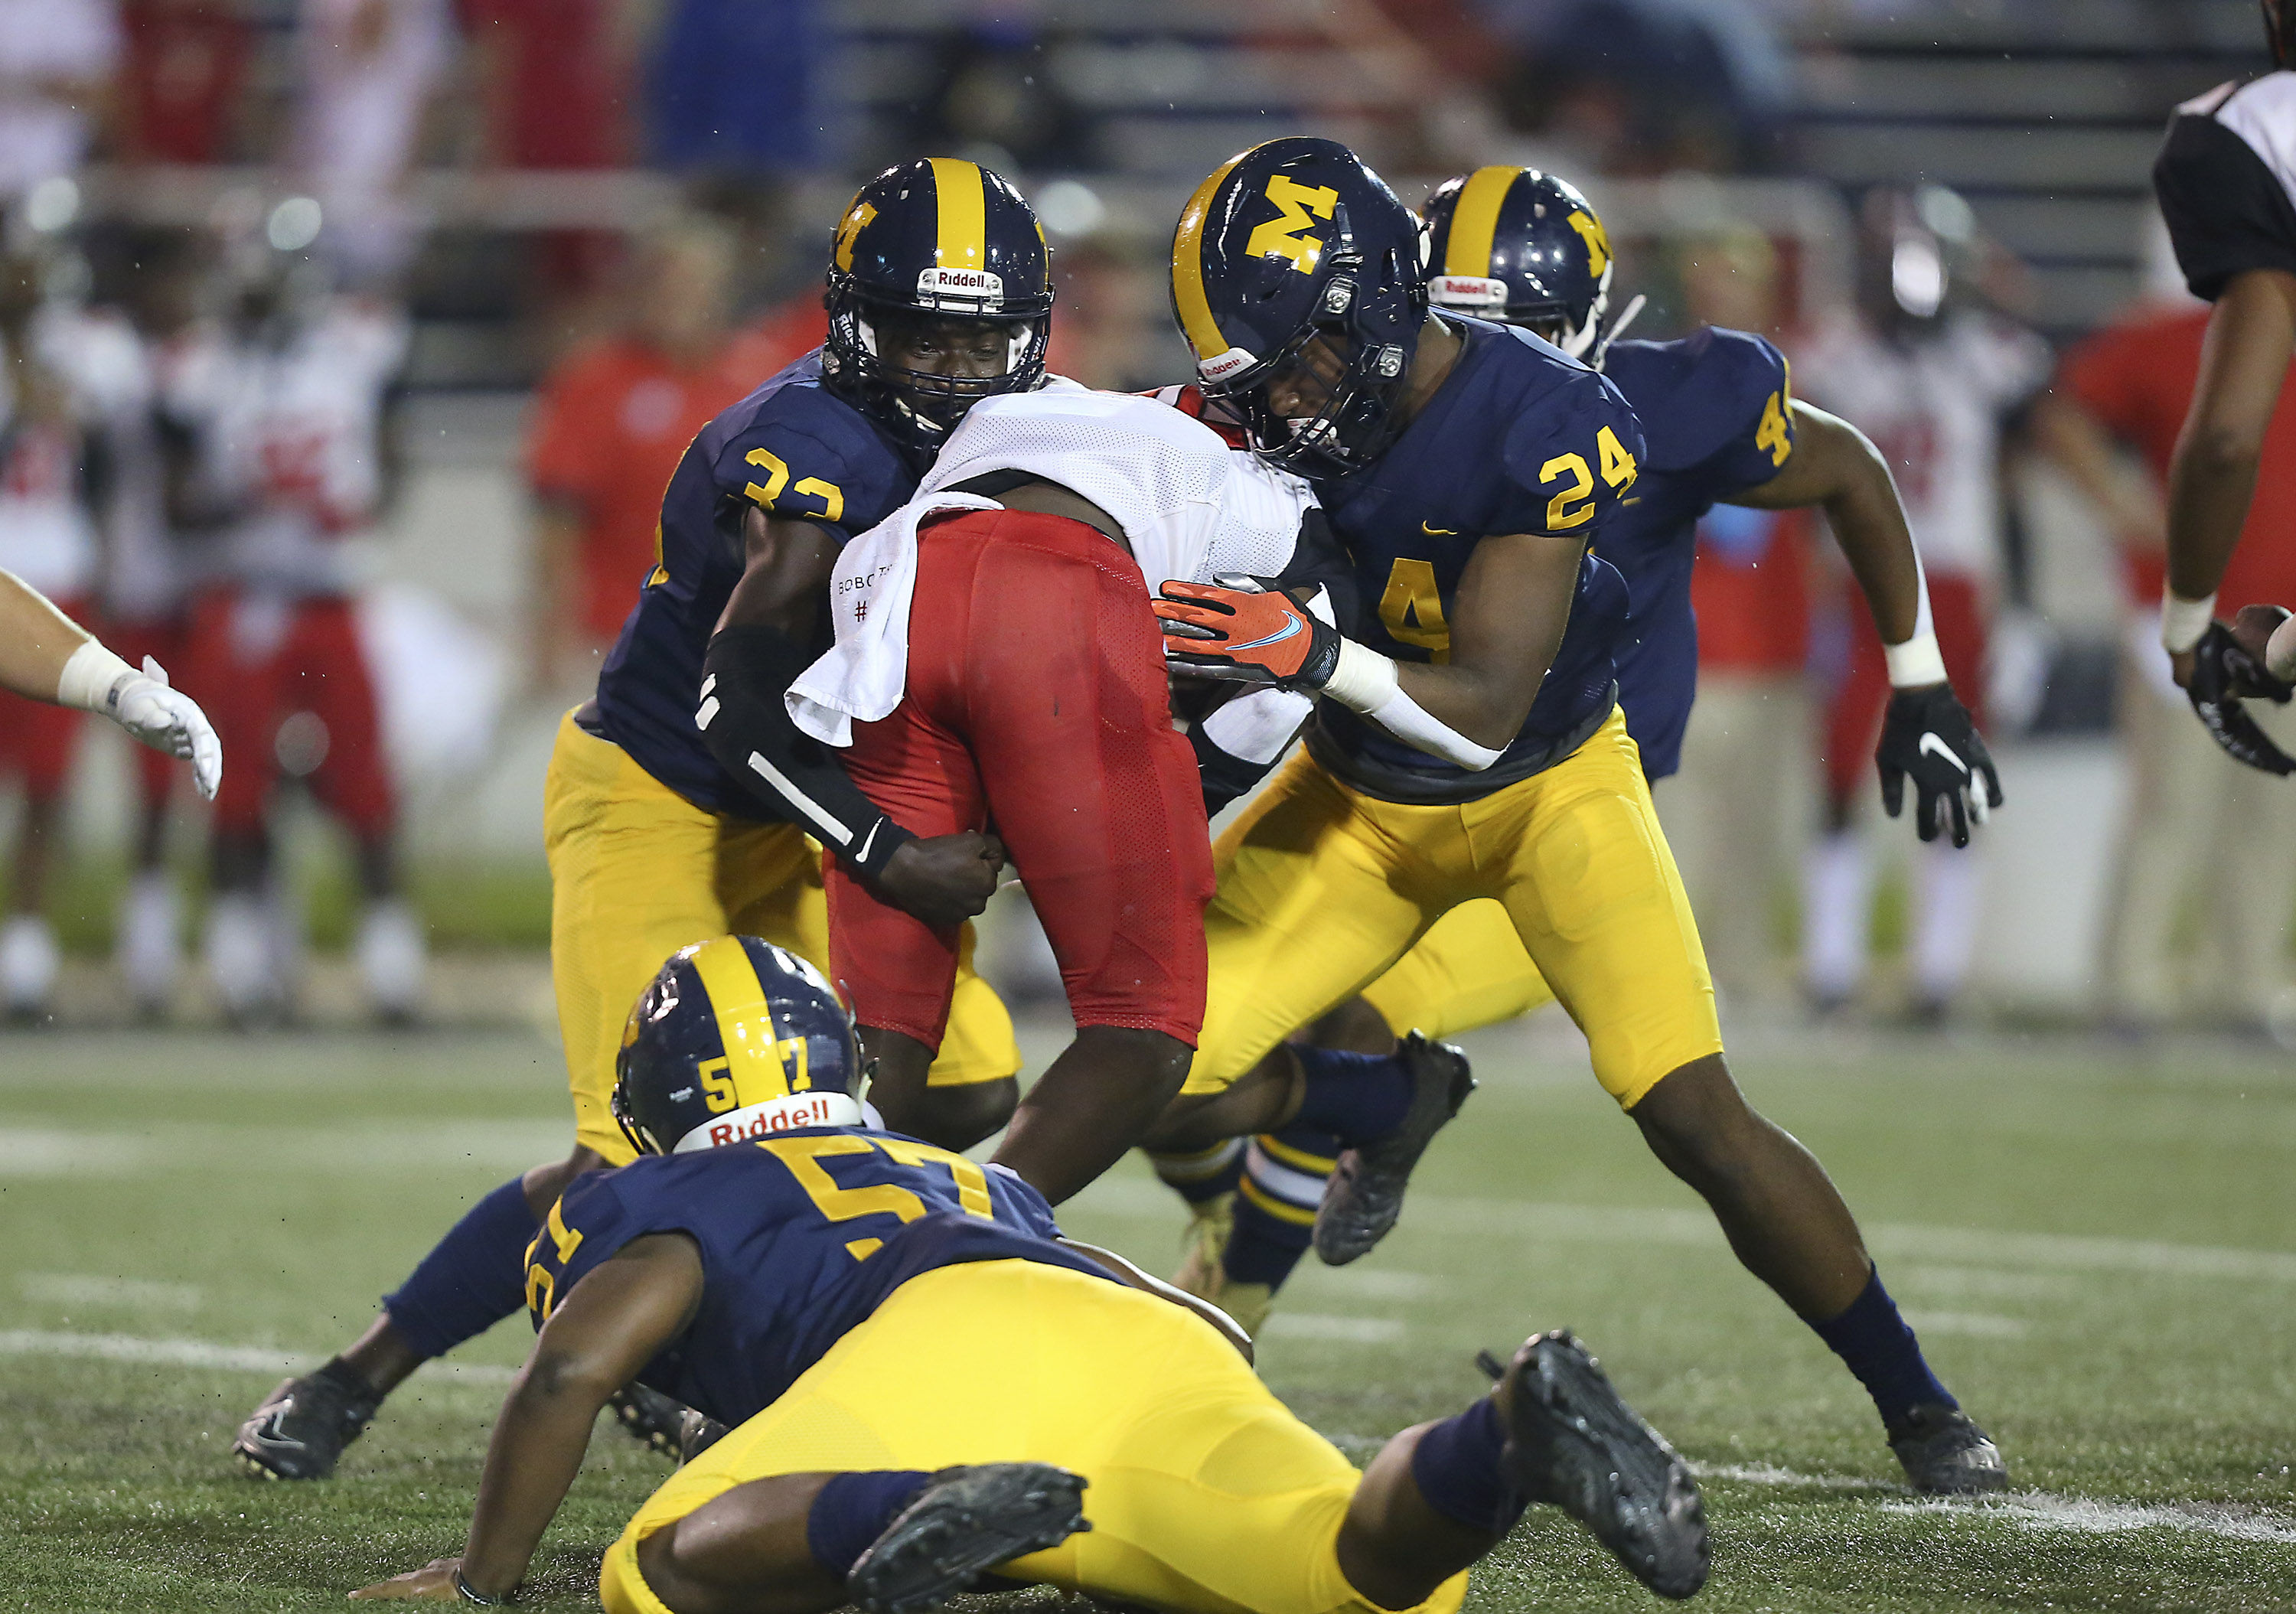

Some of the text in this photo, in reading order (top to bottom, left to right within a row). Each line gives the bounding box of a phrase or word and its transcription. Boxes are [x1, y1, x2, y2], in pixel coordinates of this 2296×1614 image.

[1244, 174, 1339, 276] M
[938, 272, 985, 288] Riddell
[1538, 425, 1638, 530] 24
[1755, 390, 1792, 468] 4
[1378, 557, 1450, 664] 4
[709, 1099, 830, 1147] Riddell
[755, 1134, 994, 1263] 57
